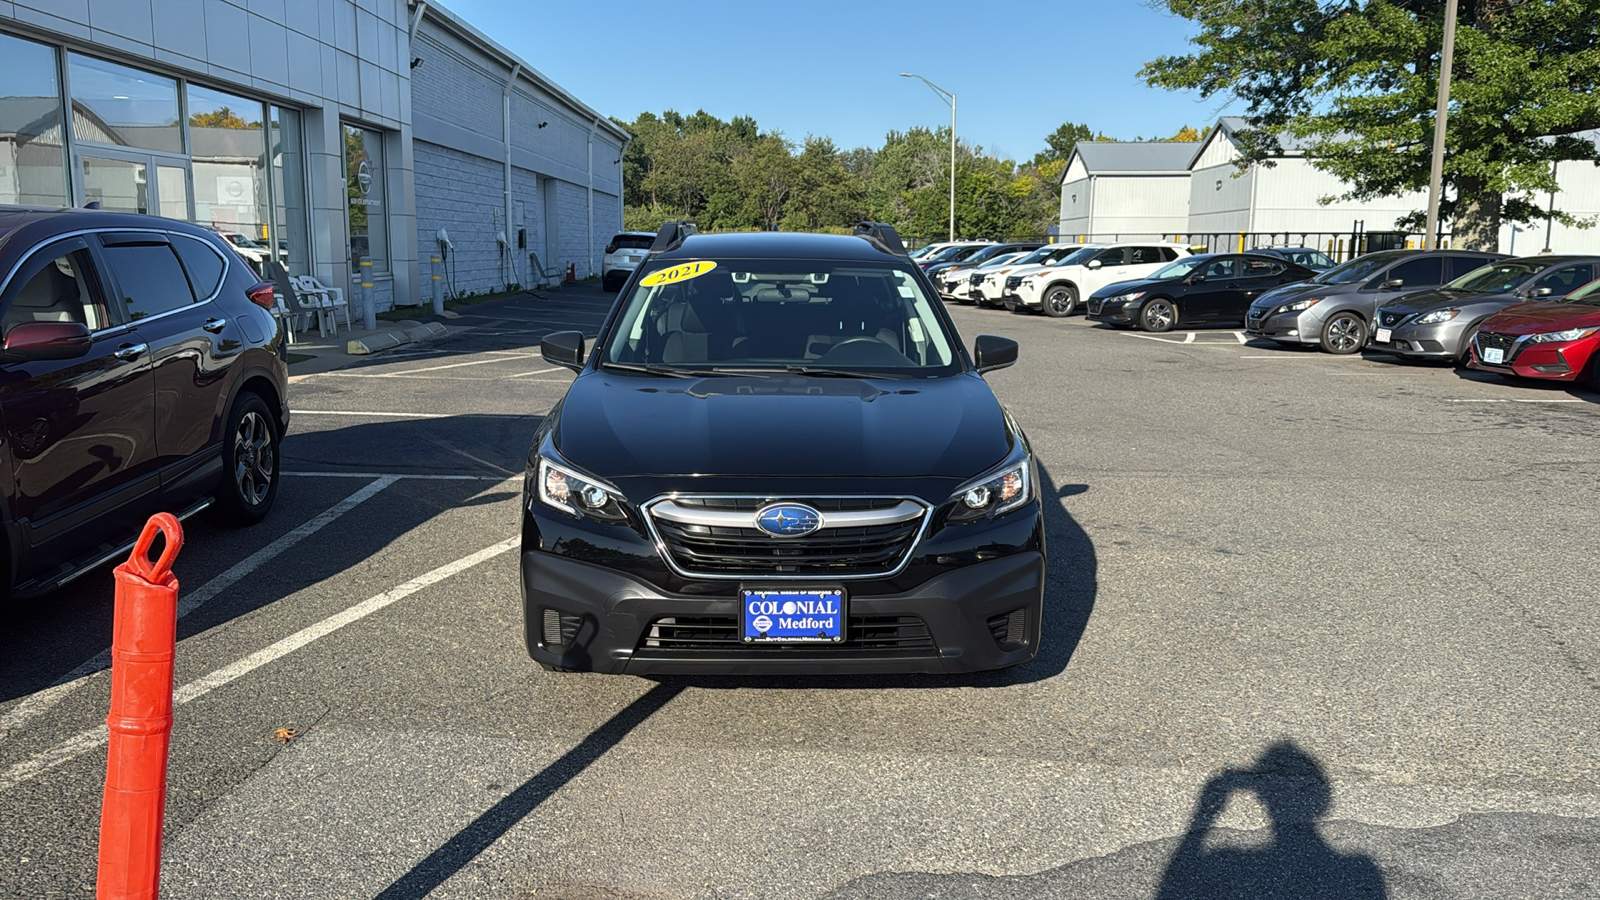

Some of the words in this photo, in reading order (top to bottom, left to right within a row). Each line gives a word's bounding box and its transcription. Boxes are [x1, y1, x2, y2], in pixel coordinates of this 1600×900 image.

[656, 263, 701, 284] 2021
[748, 600, 838, 615] COLONIAL
[778, 617, 833, 629] Medford
